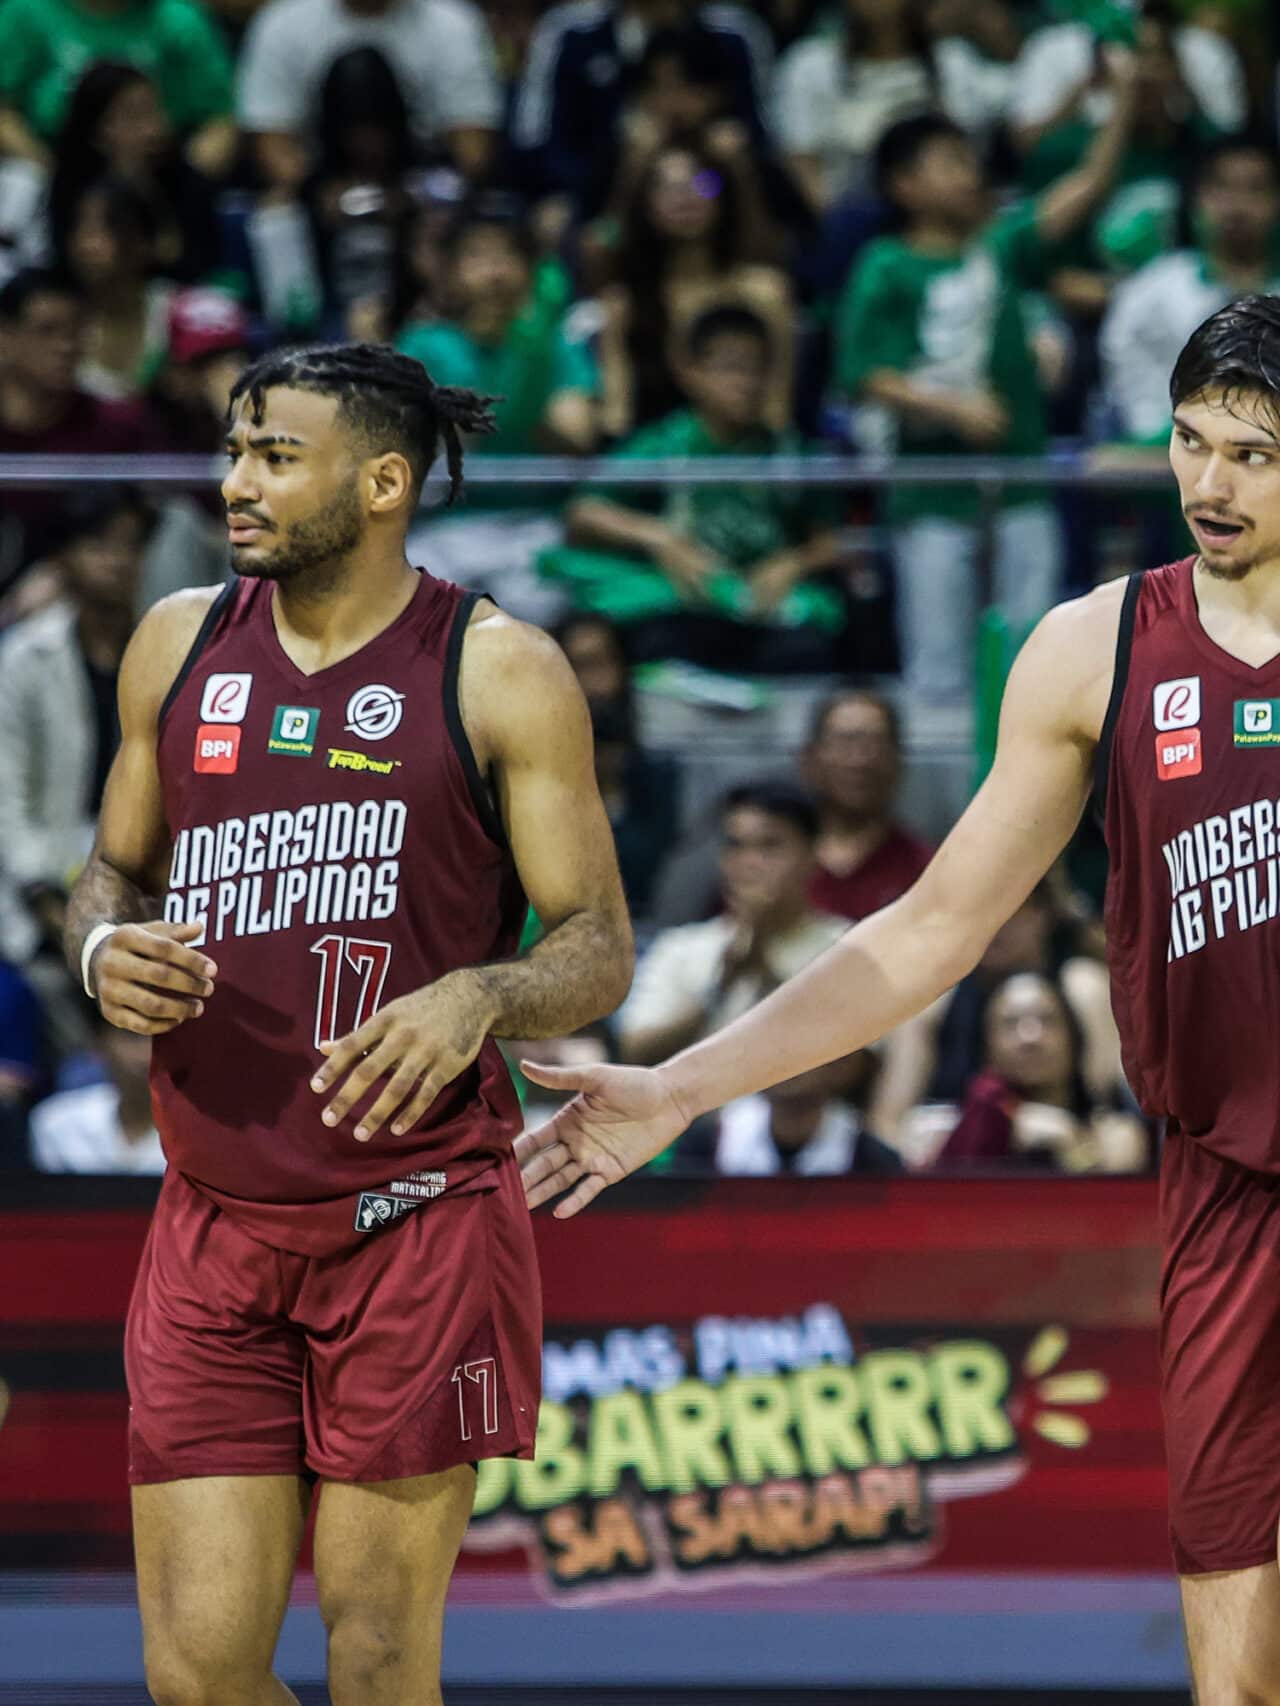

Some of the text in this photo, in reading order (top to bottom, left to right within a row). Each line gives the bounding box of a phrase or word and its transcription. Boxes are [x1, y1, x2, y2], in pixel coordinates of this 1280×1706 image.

[200, 739, 233, 759] BPI
[1162, 742, 1196, 766] BPI
[168, 799, 408, 890] UNIBERSIDAD
[215, 859, 400, 942] PILIPINAS
[309, 934, 392, 1051] 17
[451, 1357, 499, 1441] 17
